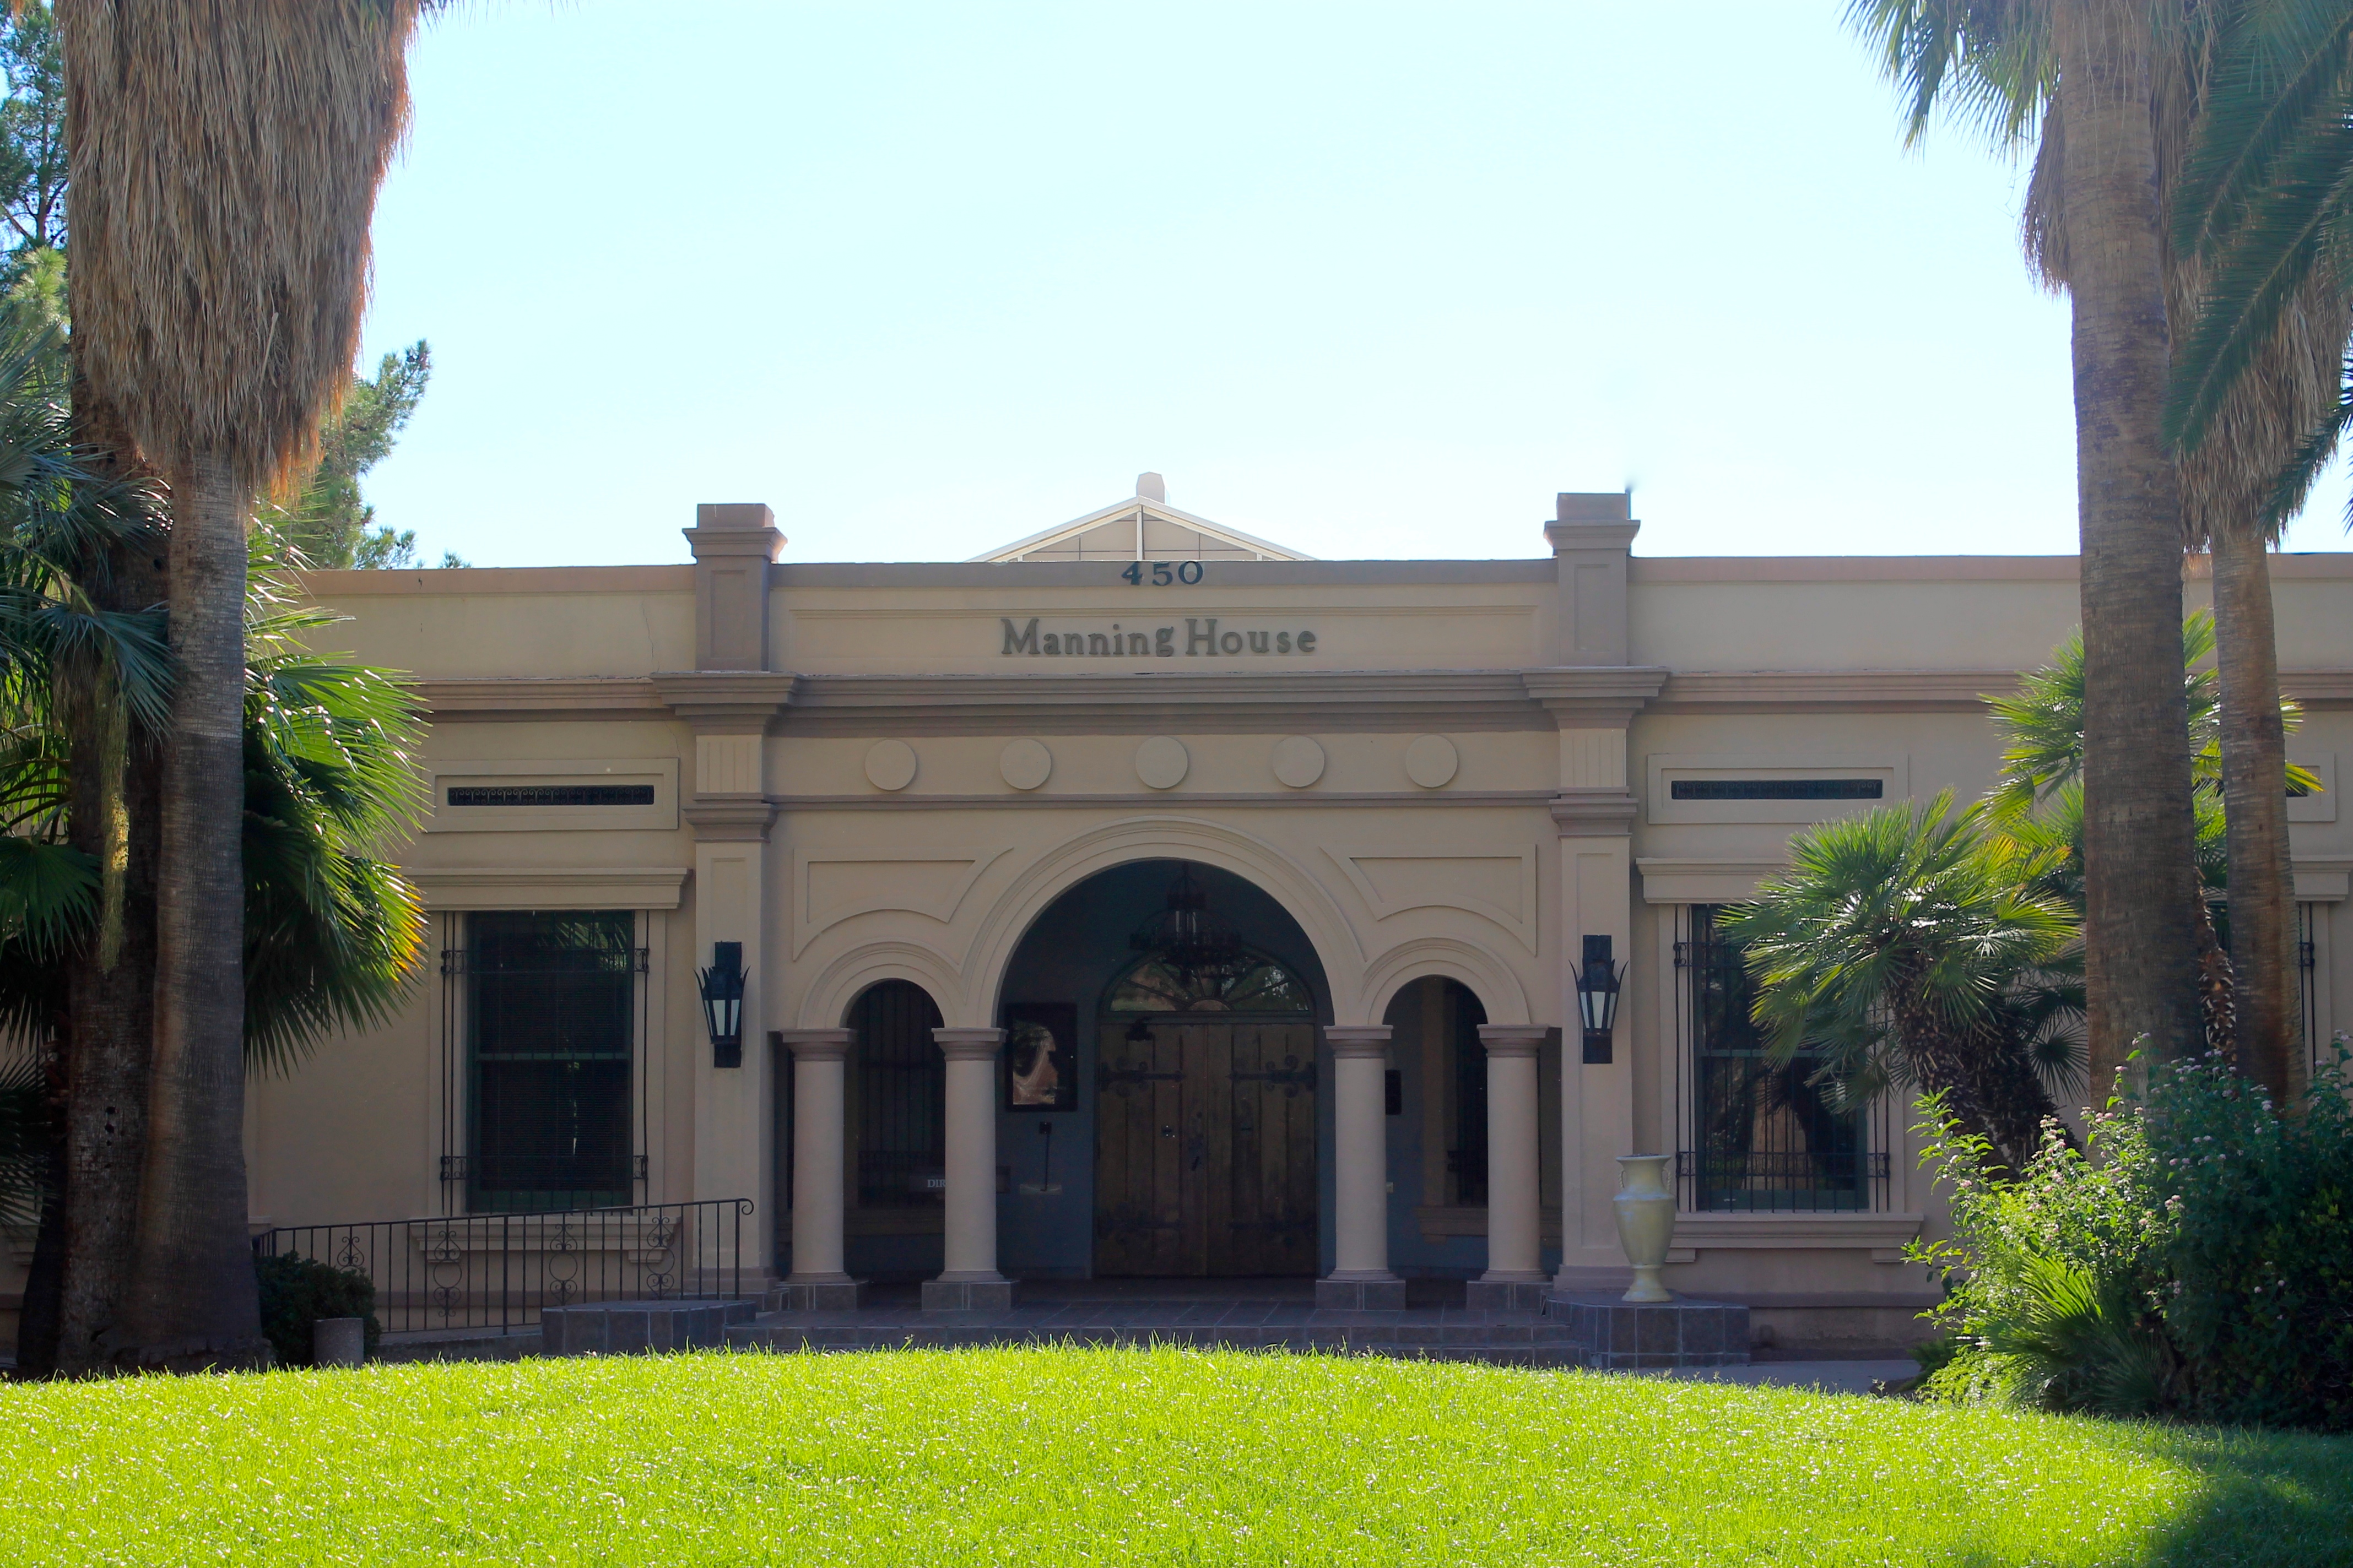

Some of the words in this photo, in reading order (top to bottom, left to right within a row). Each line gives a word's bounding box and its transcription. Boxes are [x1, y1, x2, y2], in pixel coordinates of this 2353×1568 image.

[1121, 561, 1203, 585] 450
[1000, 618, 1174, 657] Manning
[1185, 618, 1316, 654] House
